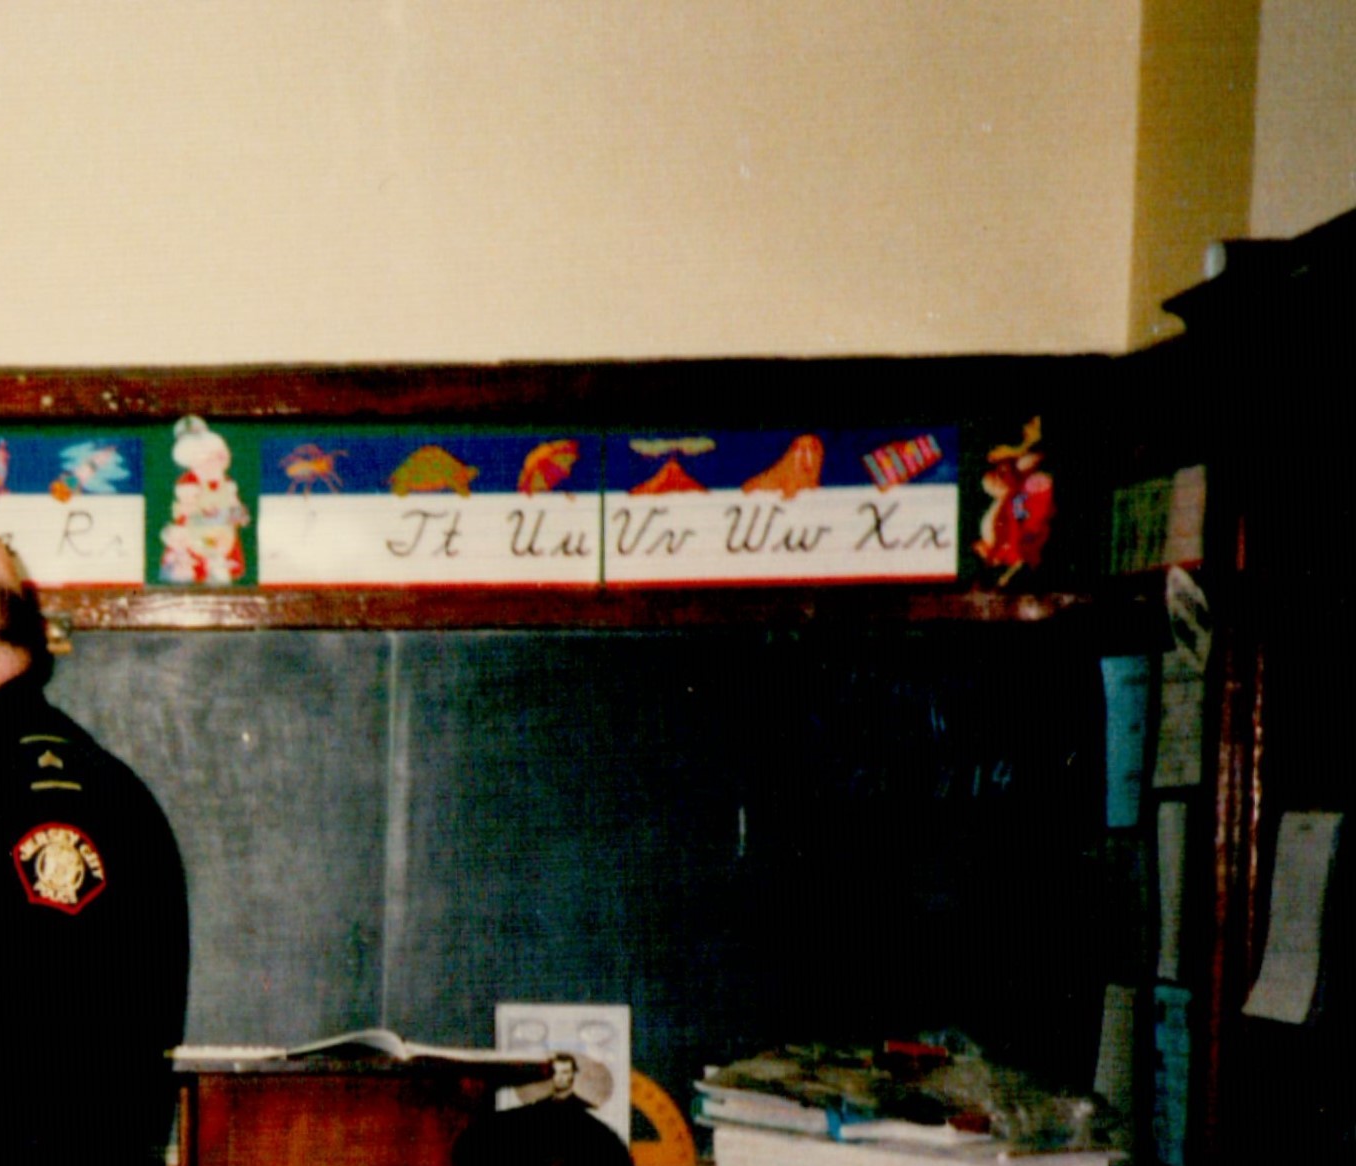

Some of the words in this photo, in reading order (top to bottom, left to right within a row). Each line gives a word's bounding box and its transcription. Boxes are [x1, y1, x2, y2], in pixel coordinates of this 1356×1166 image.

[385, 508, 462, 558] Tt
[507, 508, 591, 558] Uu
[612, 506, 696, 558] Vv
[724, 504, 832, 557] Ww
[852, 502, 951, 553] Xx
